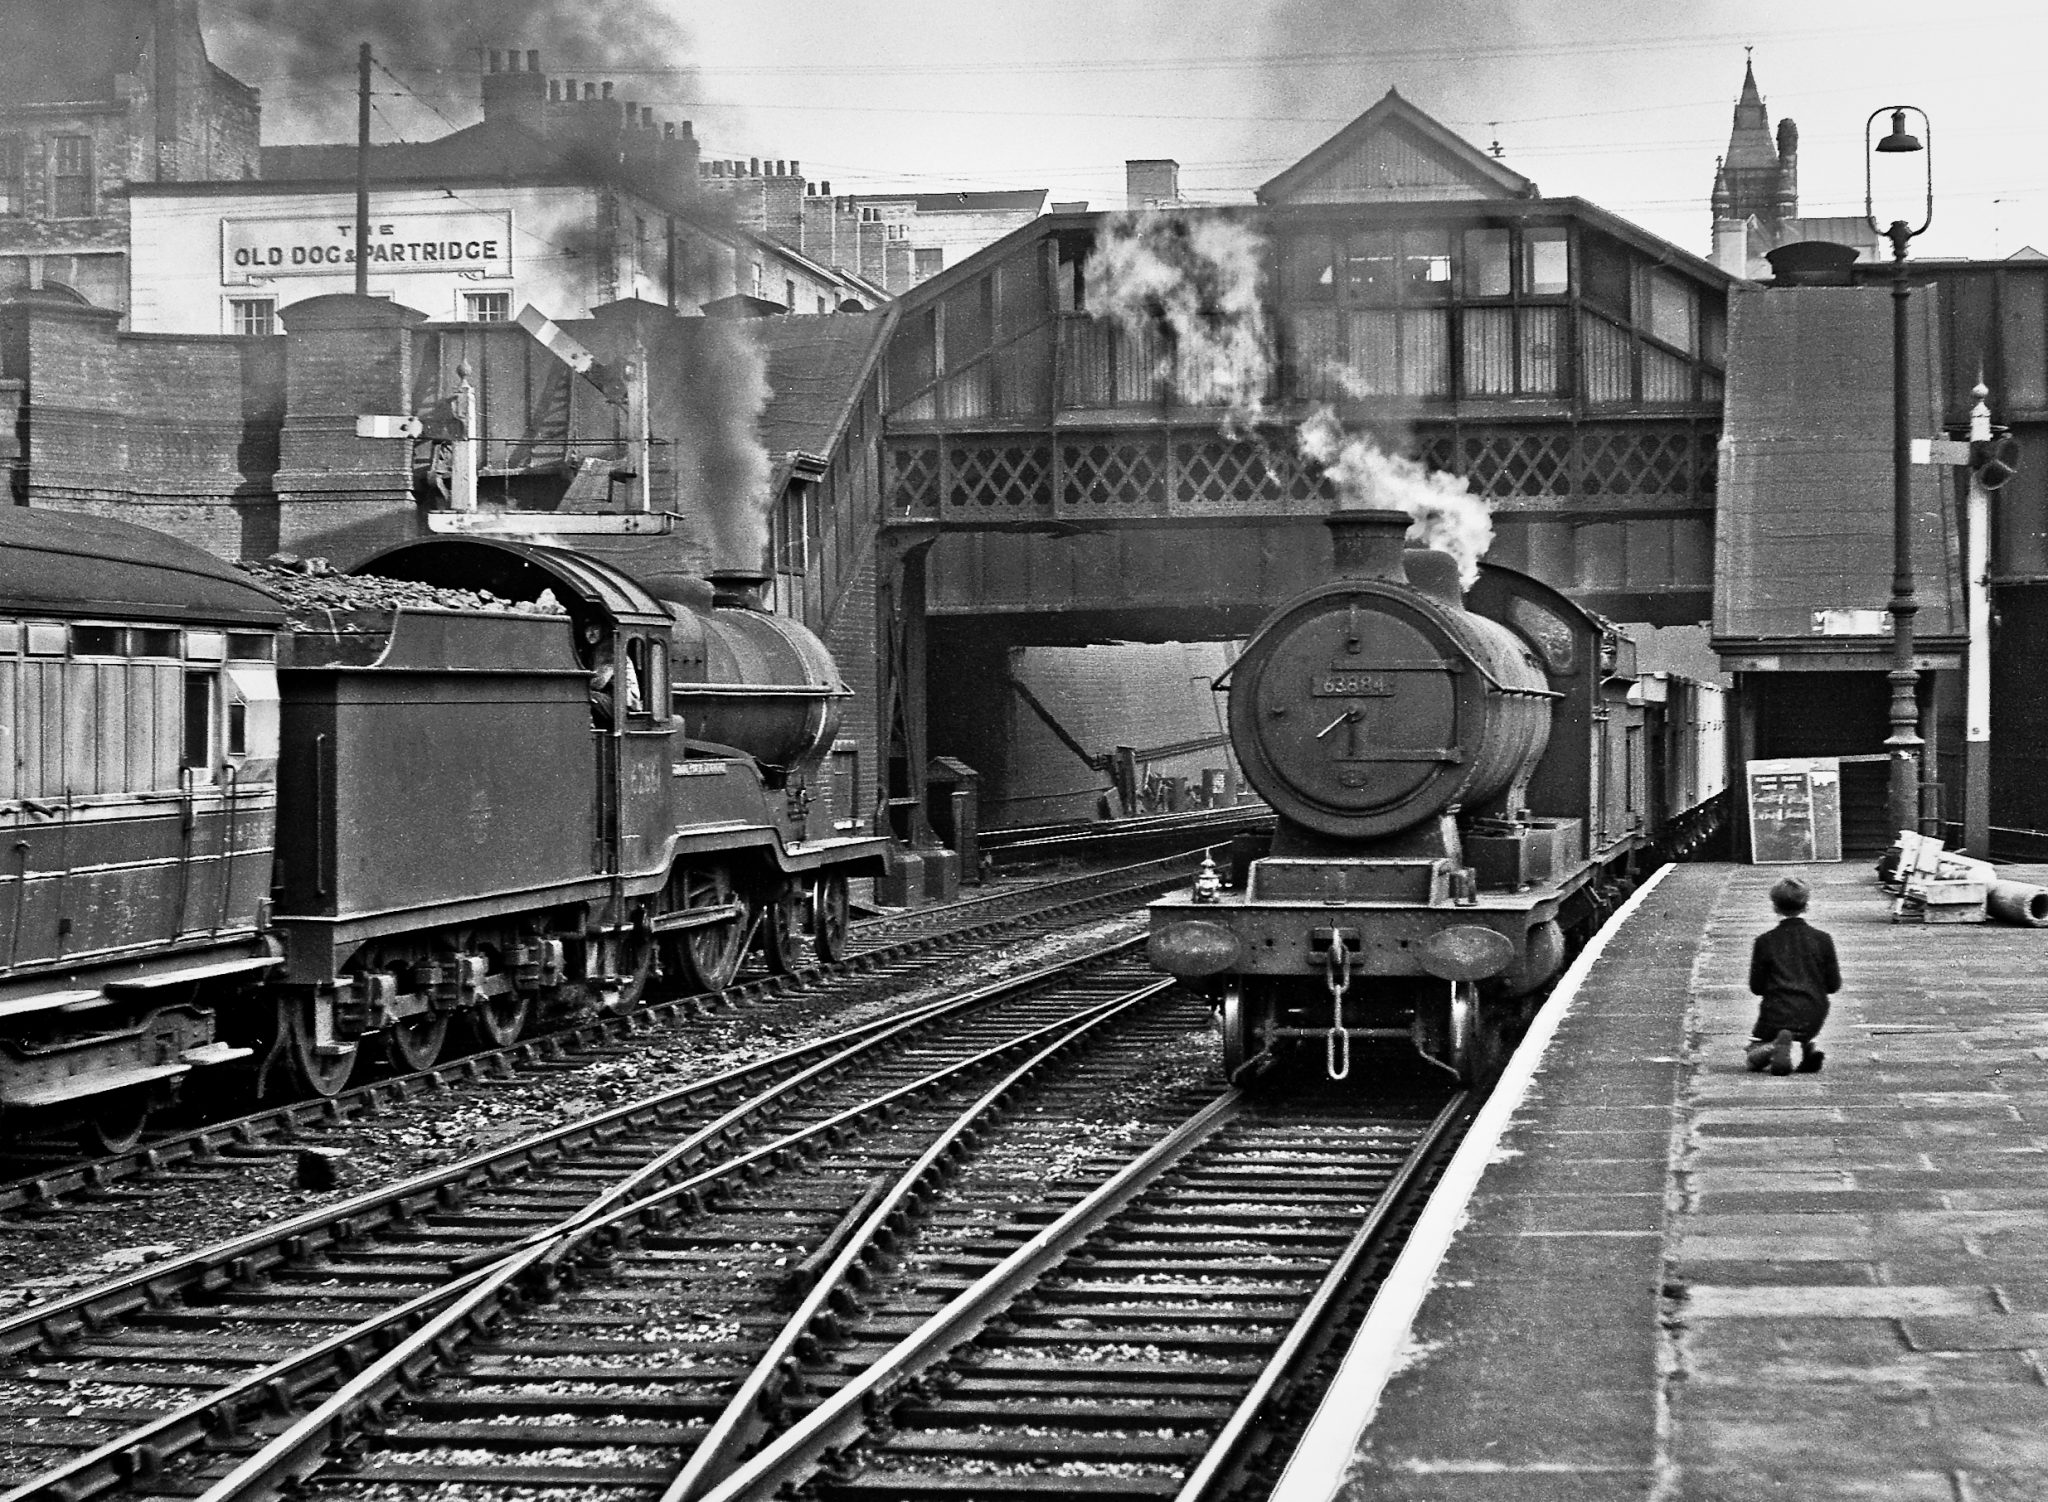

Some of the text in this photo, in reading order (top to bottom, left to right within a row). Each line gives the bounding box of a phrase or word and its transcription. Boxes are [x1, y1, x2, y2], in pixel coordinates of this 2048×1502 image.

[337, 224, 394, 236] TE
[234, 246, 283, 266] OLD
[291, 245, 341, 264] DOG
[344, 249, 358, 263] &
